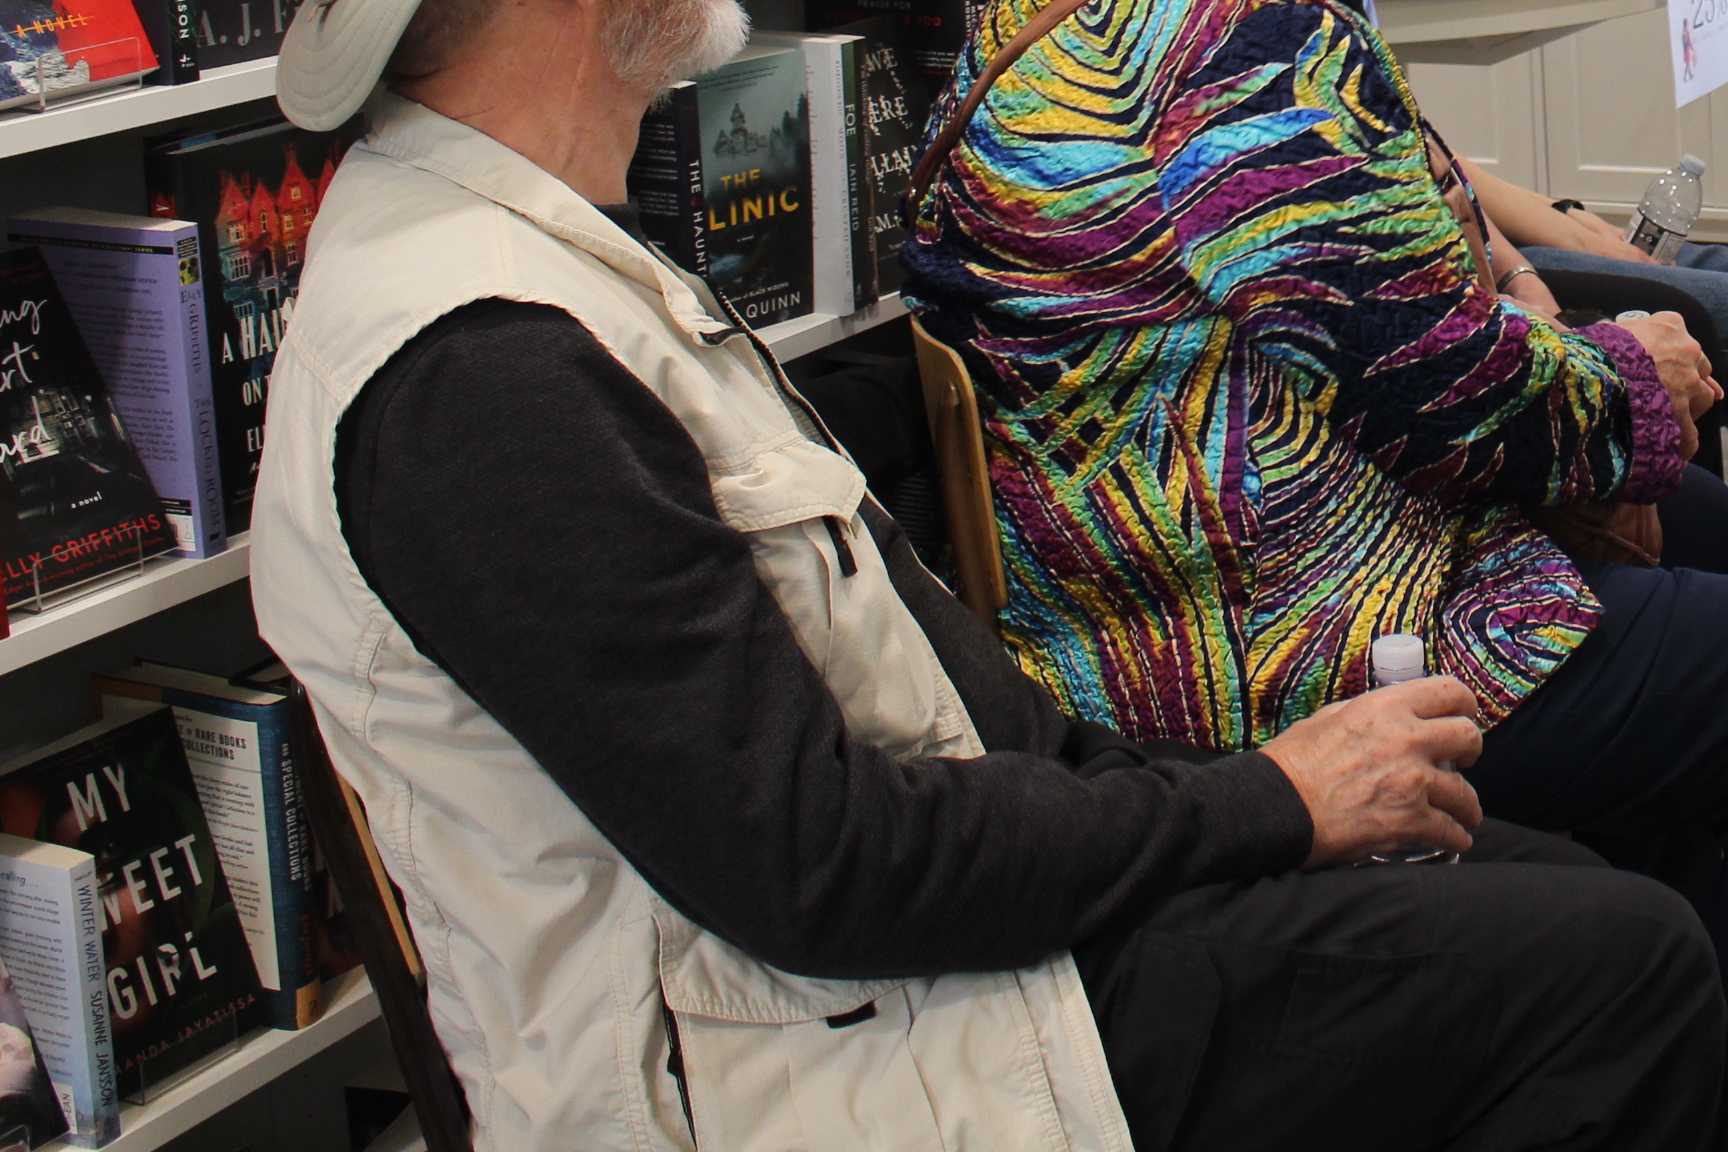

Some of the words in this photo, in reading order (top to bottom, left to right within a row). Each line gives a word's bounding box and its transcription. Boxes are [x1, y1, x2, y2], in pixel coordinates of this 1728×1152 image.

[32, 12, 88, 35] NOVEL
[237, 2, 262, 47] J.
[844, 103, 857, 137] FOE
[689, 159, 702, 195] THE
[719, 168, 762, 192] THE
[849, 162, 858, 193] IAIN
[850, 197, 861, 232] REID
[745, 290, 801, 320] QUINN
[221, 331, 234, 365] A
[241, 377, 263, 407] ON
[78, 491, 103, 508] novel
[51, 513, 162, 563] GRIFFITHS
[195, 728, 217, 744] RARE
[218, 733, 247, 750] BOOKS
[66, 762, 132, 832] MY
[281, 758, 295, 806] SPECIAL
[285, 807, 302, 882] COLLECTIONS
[77, 883, 95, 938] WINTER
[84, 939, 100, 984] WATER
[105, 930, 218, 1021] GIRL
[89, 989, 107, 1047] SUSANNE
[96, 1051, 113, 1108] JANSSON
